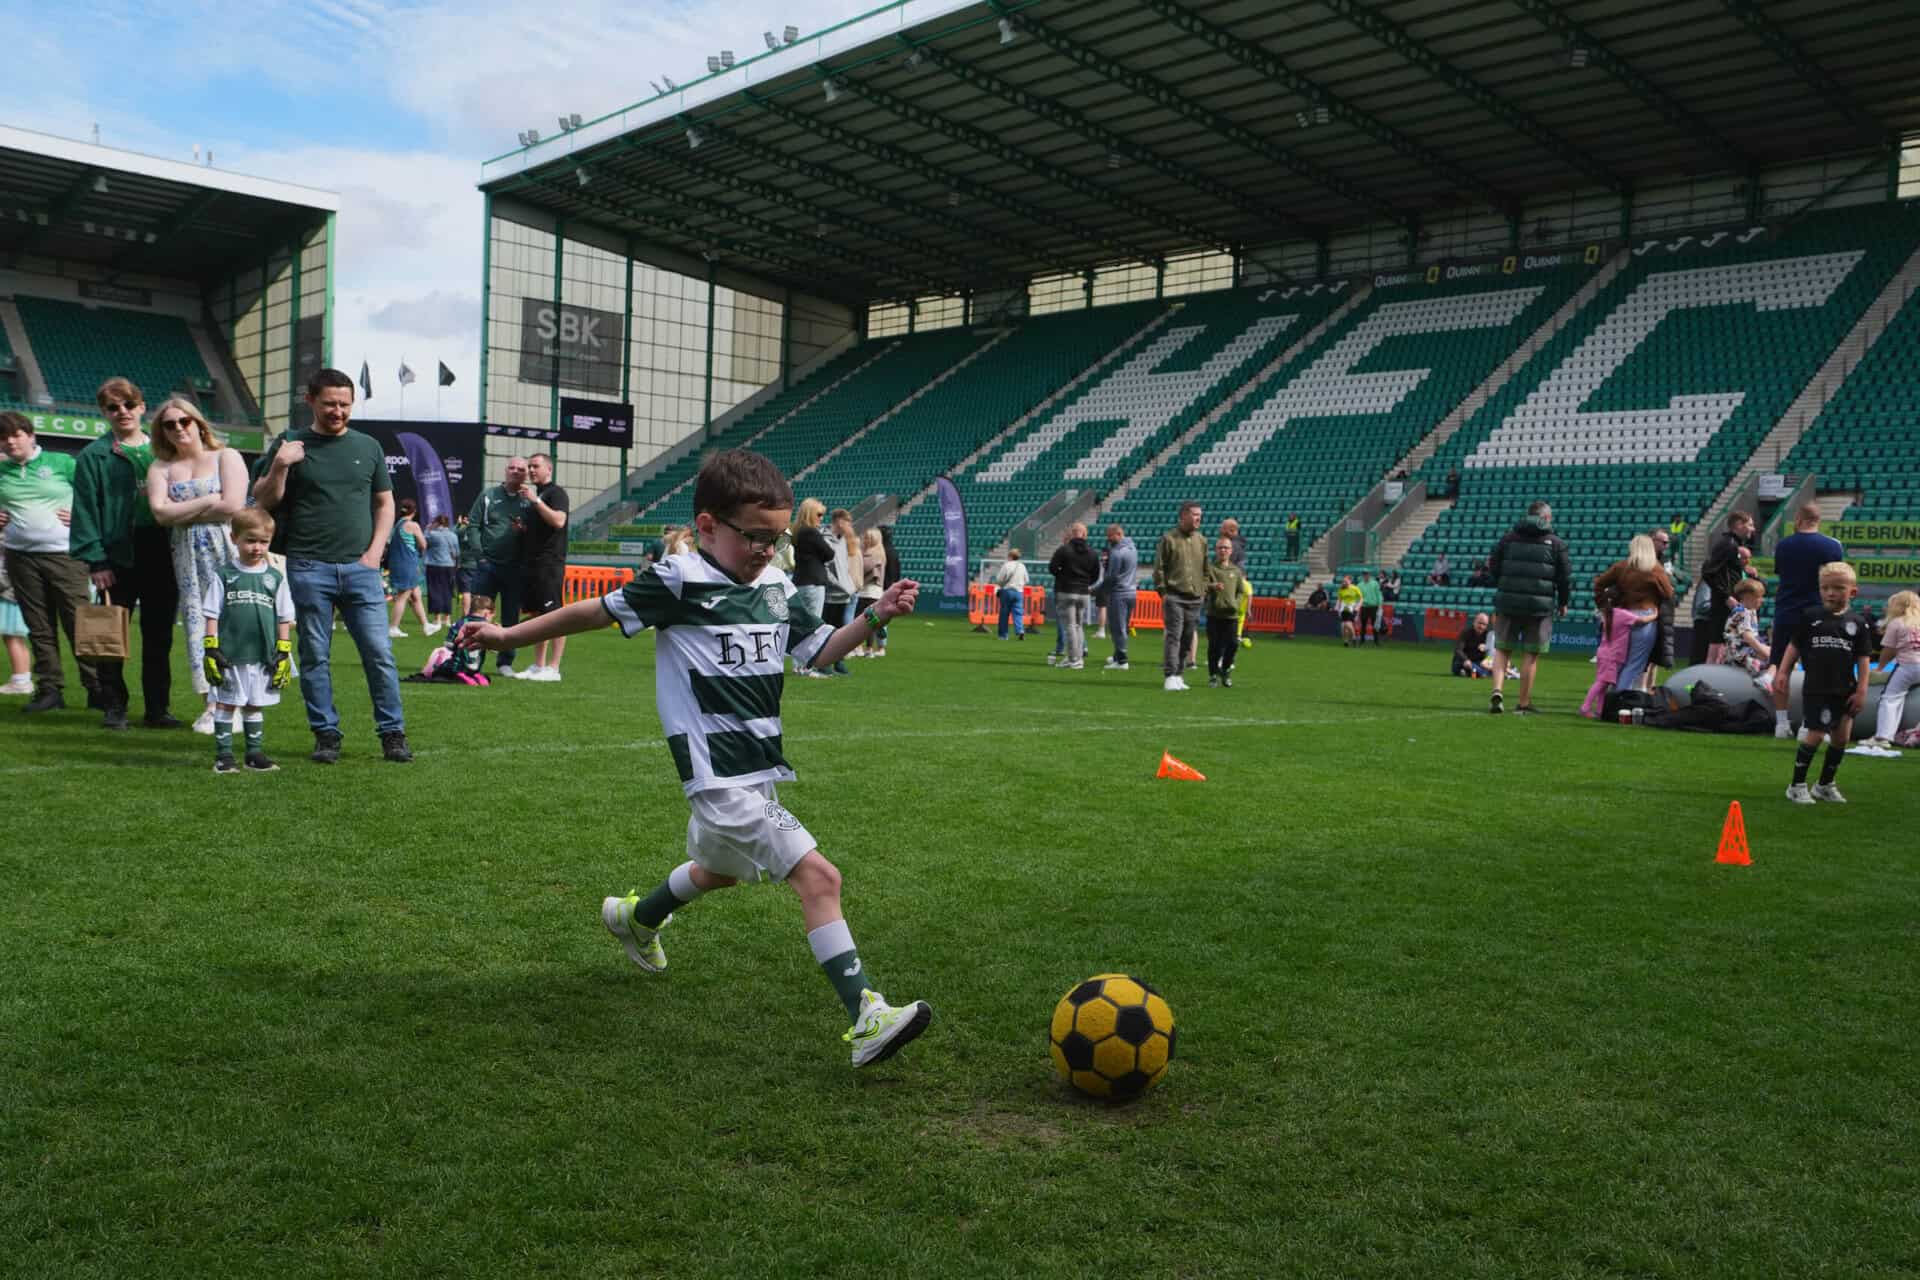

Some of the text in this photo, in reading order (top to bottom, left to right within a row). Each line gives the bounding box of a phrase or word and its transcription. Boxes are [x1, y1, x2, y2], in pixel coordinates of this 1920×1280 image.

[535, 308, 602, 347] SBK
[1830, 526, 1920, 539] THE BRUN
